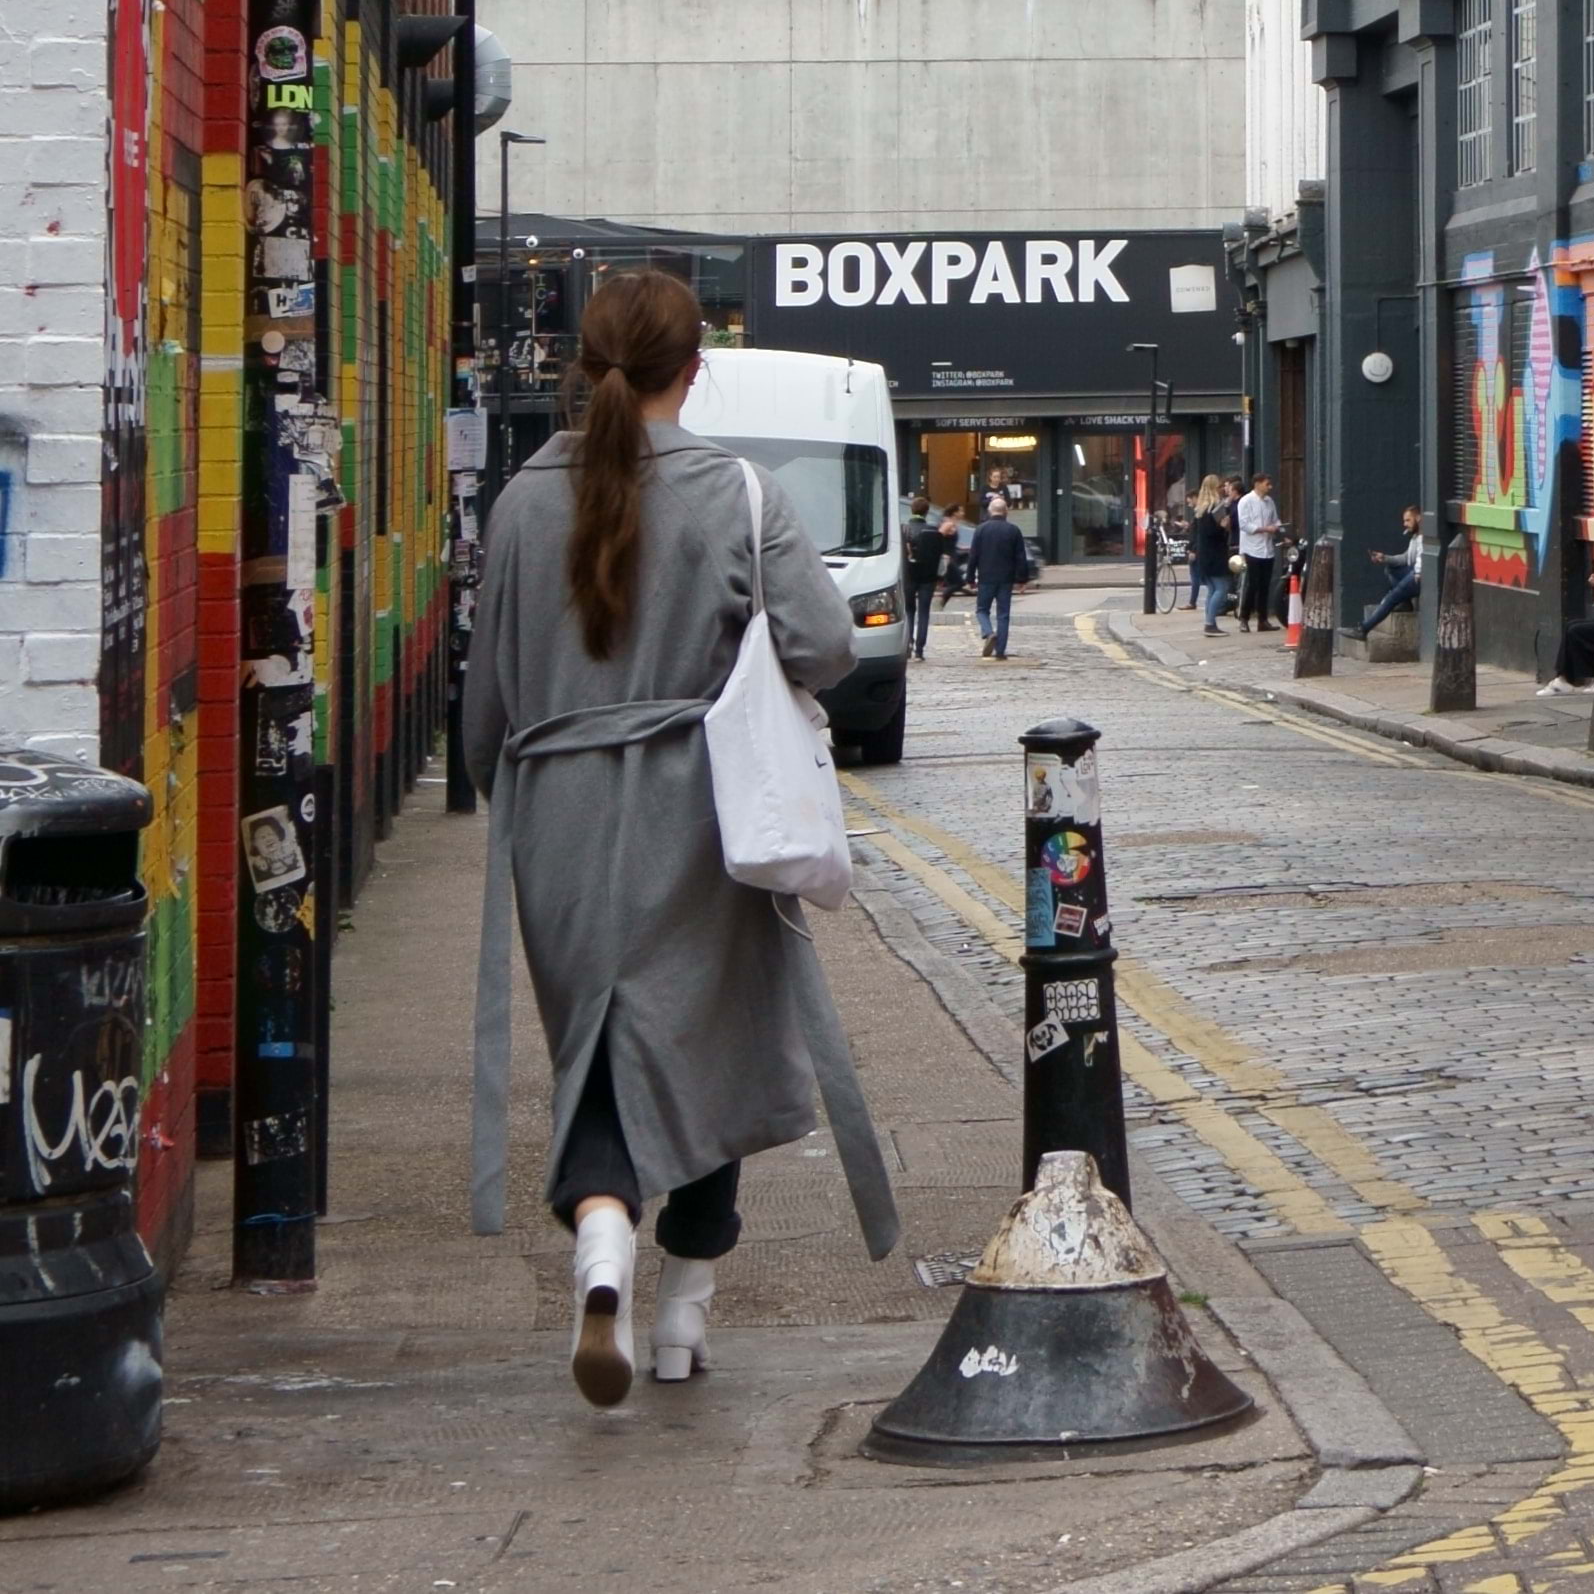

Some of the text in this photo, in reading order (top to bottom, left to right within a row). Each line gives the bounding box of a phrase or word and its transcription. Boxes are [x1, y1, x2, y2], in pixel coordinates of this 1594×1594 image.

[775, 239, 1131, 307] BOXPARK
[935, 416, 1026, 428] SOFT SERVE SOCIETY
[1080, 416, 1103, 425] LOVE
[1104, 415, 1134, 424] SHACK
